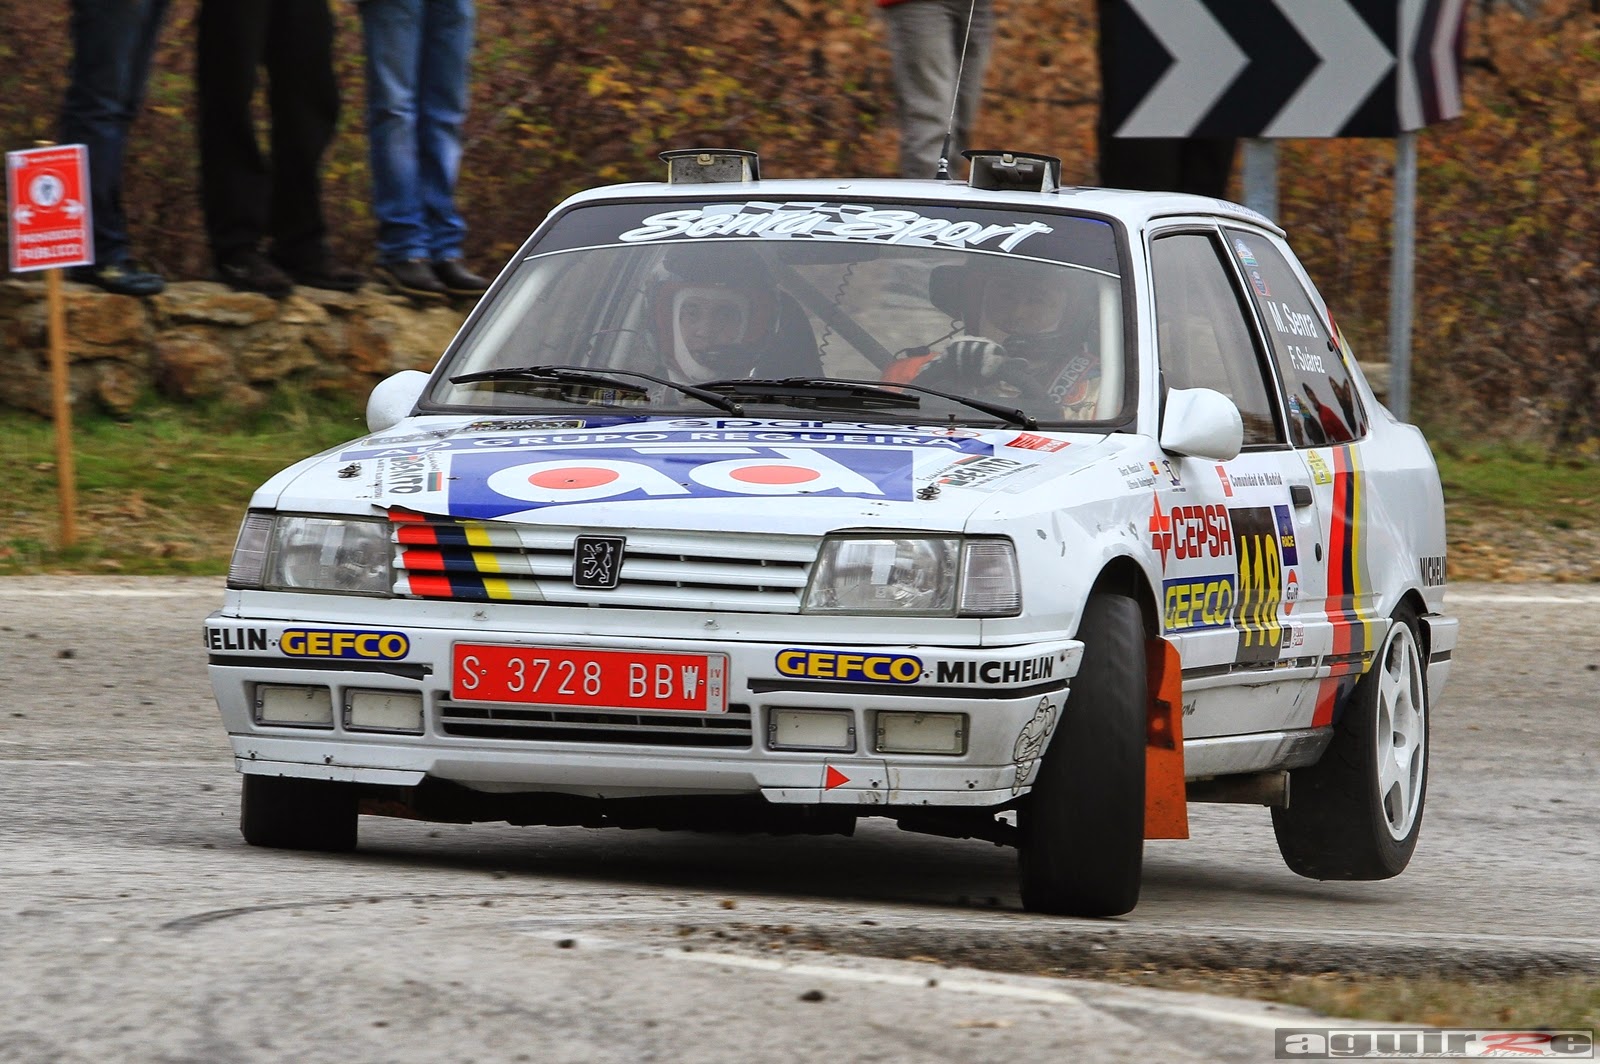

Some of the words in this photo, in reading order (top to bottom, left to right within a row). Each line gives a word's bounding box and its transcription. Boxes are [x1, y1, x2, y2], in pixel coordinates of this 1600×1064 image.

[832, 210, 1054, 253] Sport
[1266, 300, 1289, 334] M.
[1281, 302, 1319, 338] Senra
[1287, 345, 1300, 370] F.
[1295, 346, 1326, 374] Suárez
[474, 432, 668, 446] GRUPO
[690, 431, 962, 449] REGUEIRA
[1230, 473, 1258, 487] Comunidad
[1263, 471, 1283, 486] Madrid
[1171, 503, 1233, 560] CEPSA
[1165, 579, 1233, 630] GEFCO
[1239, 533, 1282, 647] 118
[1286, 586, 1299, 601] Gulf
[279, 631, 408, 658] GEFCO
[462, 655, 481, 691] S
[507, 657, 602, 696] 3728
[776, 650, 922, 682] GEFCO
[936, 655, 1055, 683] MICHELIN
